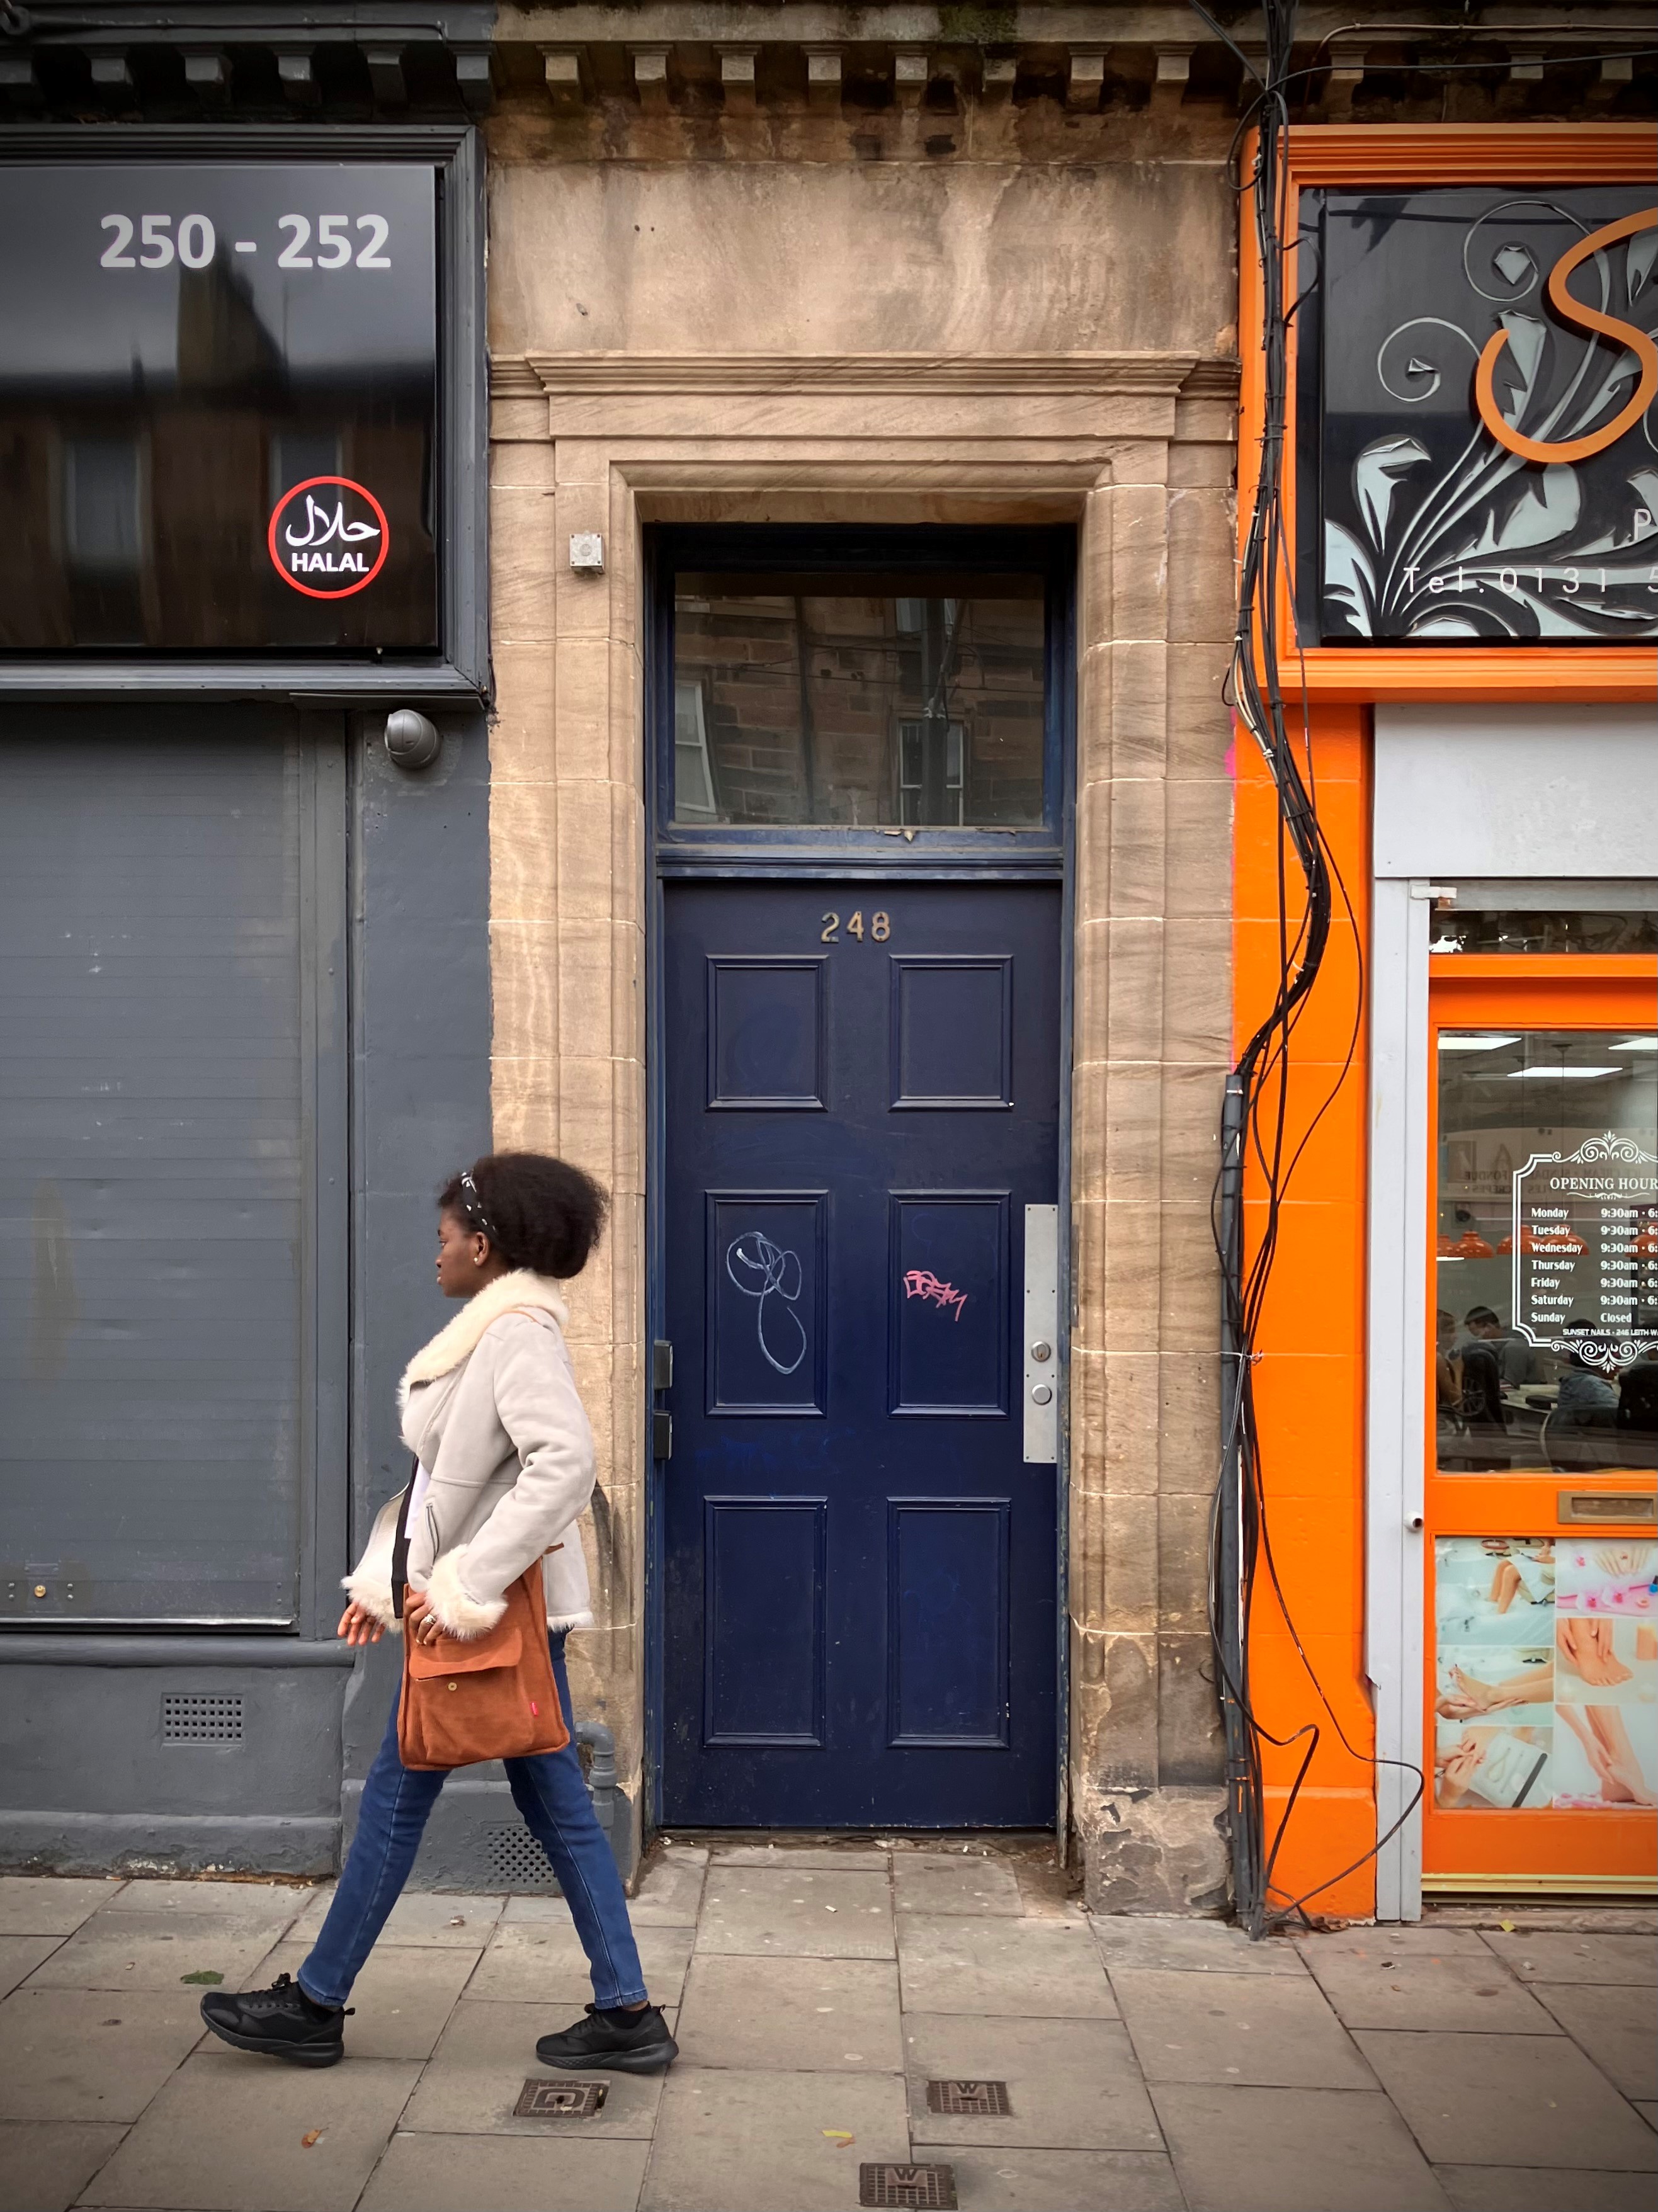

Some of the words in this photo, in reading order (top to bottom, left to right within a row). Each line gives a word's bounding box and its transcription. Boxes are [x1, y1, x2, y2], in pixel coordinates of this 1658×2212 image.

[99, 214, 215, 269] 250
[235, 242, 257, 252] -
[278, 214, 392, 269] 252
[285, 495, 381, 547] حلال
[292, 552, 370, 572] HALAL
[821, 911, 890, 943] 248
[1550, 1177, 1614, 1190] OPENING
[1618, 1177, 1658, 1190] HOUR
[1531, 1207, 1569, 1220] Monday
[1601, 1208, 1638, 1218] 9:30am
[1531, 1225, 1570, 1238] Tuesday
[1531, 1242, 1583, 1255] Wednesday
[1601, 1243, 1638, 1253] 9:30am
[1531, 1259, 1576, 1273] Thursday
[1600, 1260, 1638, 1270] 9:30am
[1531, 1277, 1560, 1290] Friday
[1600, 1278, 1638, 1288] 9:30am
[1531, 1294, 1574, 1308] Saturday
[1600, 1295, 1638, 1305] 9:30am
[1531, 1312, 1566, 1325] Sunday
[1600, 1312, 1632, 1323] Closed
